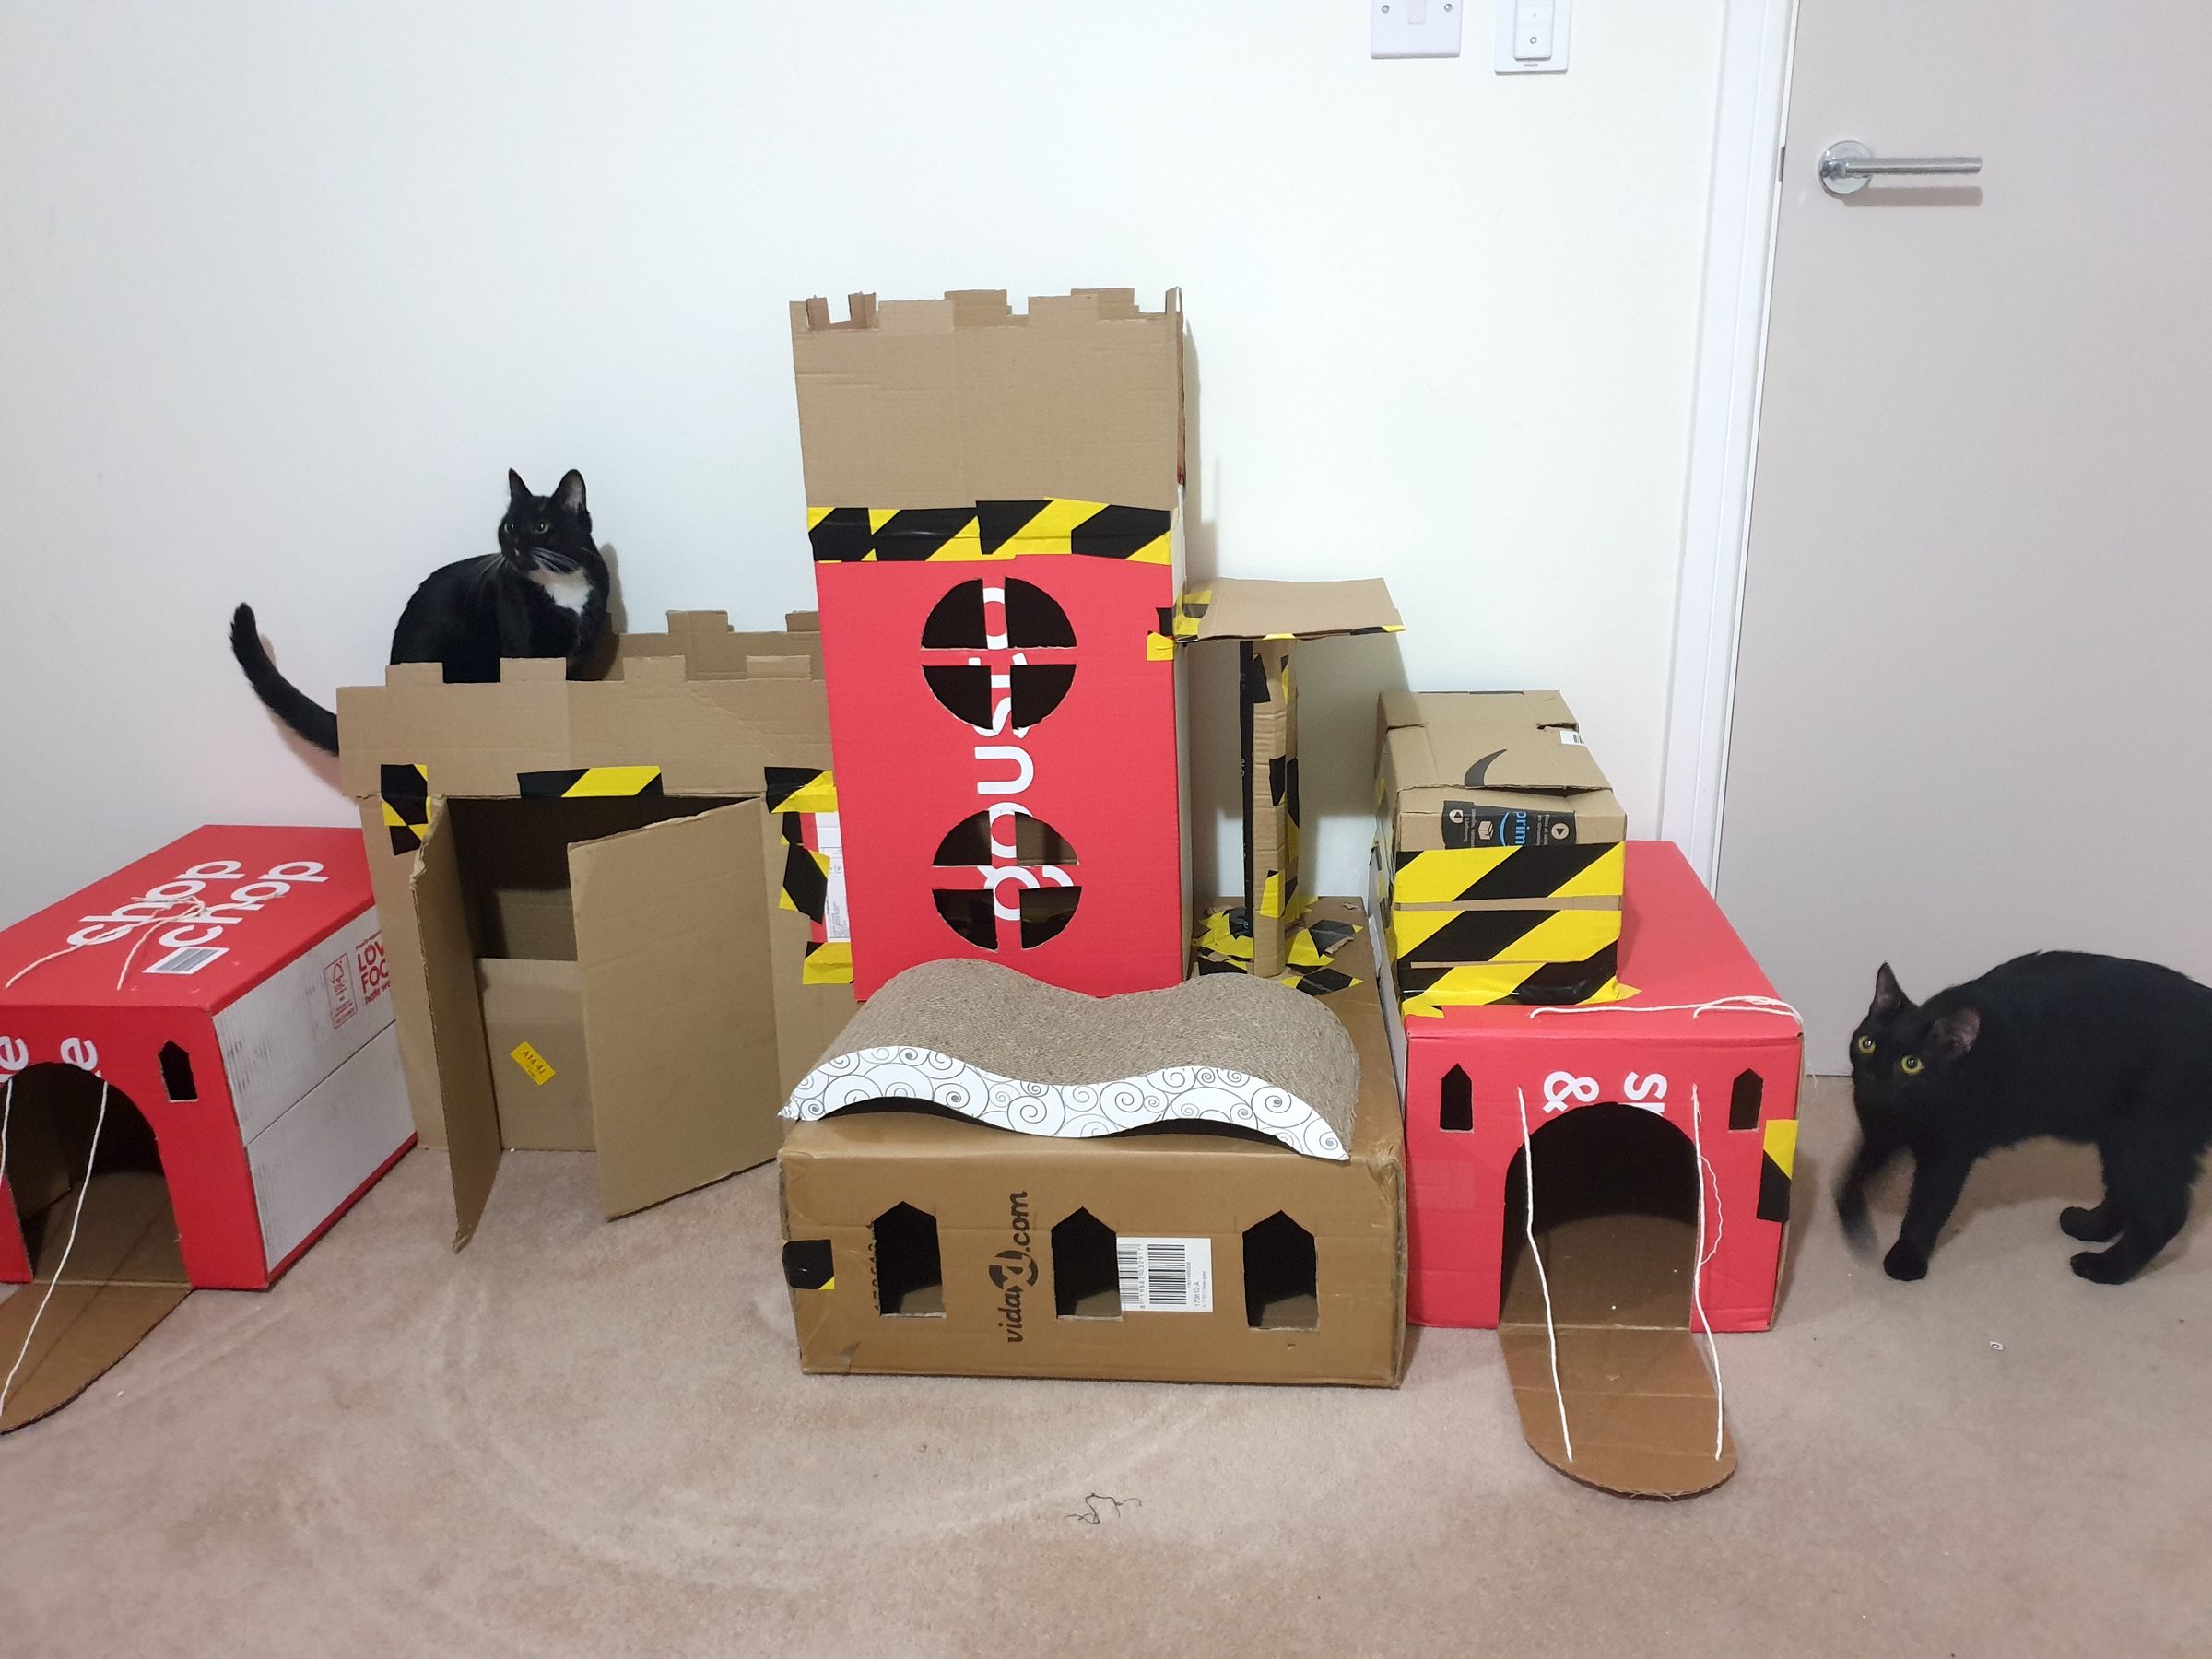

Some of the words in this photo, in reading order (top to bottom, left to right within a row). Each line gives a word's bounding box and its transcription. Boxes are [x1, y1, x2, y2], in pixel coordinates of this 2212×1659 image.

[66, 860, 245, 946] chop
[159, 861, 329, 947] chop
[1542, 1071, 1600, 1113] &
